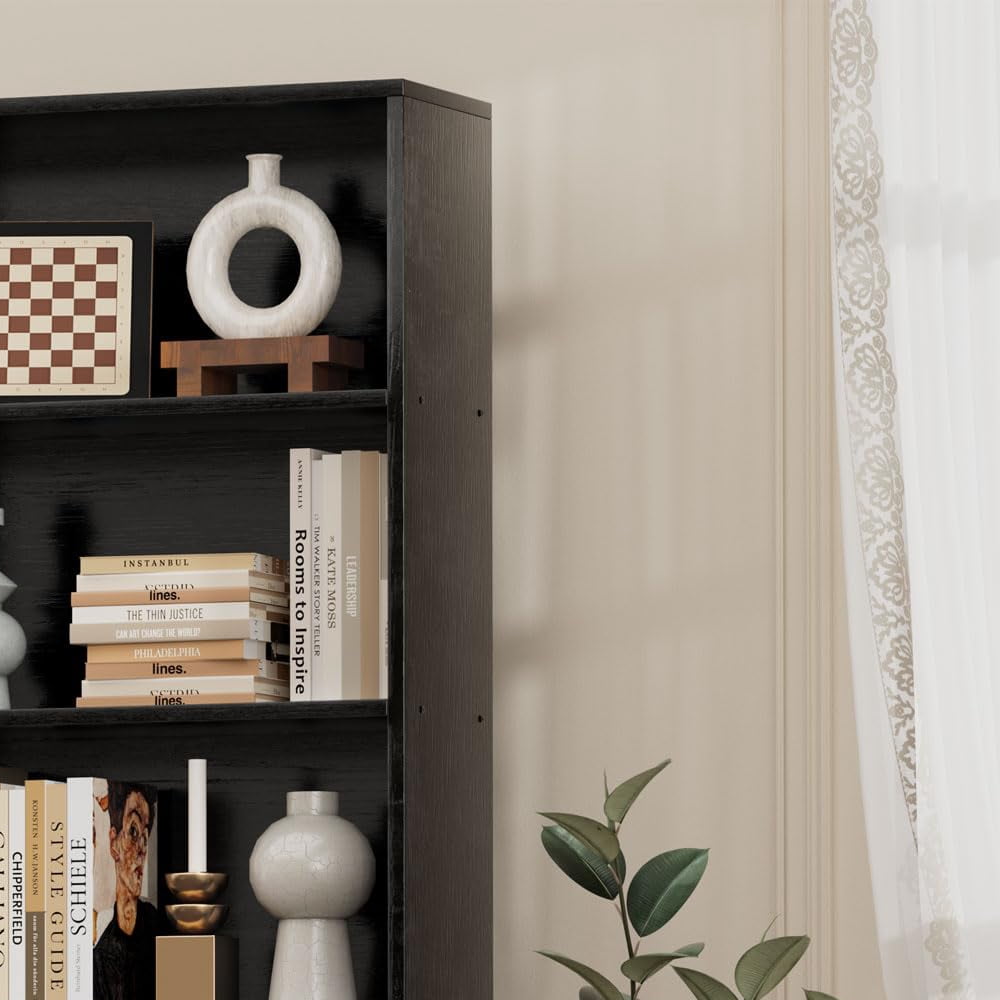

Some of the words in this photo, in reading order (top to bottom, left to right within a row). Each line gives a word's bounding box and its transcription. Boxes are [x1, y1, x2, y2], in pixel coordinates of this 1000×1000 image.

[313, 526, 321, 543] TIM
[123, 558, 190, 568] INSTANBUL
[295, 529, 307, 595] Rooms
[313, 545, 321, 587] WALKER
[327, 547, 336, 586] KATE
[149, 589, 181, 601] lines.
[346, 555, 357, 617] LEADERSHIP
[127, 609, 143, 621] THE
[146, 608, 167, 620] THIN
[169, 607, 204, 619] JUSTICE
[295, 601, 307, 621] to
[313, 589, 321, 621] STORY
[327, 590, 336, 629] MOSS
[141, 628, 163, 638] CHANGE
[165, 628, 177, 638] THE
[313, 624, 321, 657] TELLER
[134, 647, 200, 658] PHILADELPHIA
[152, 663, 187, 674] lines.
[291, 628, 308, 695] Inspire
[154, 695, 186, 706] lines.
[50, 821, 64, 898] STYLE
[12, 851, 23, 945] CHIPPERFIELD
[70, 837, 87, 936] SCHIELE
[50, 911, 64, 990] GUIDE
